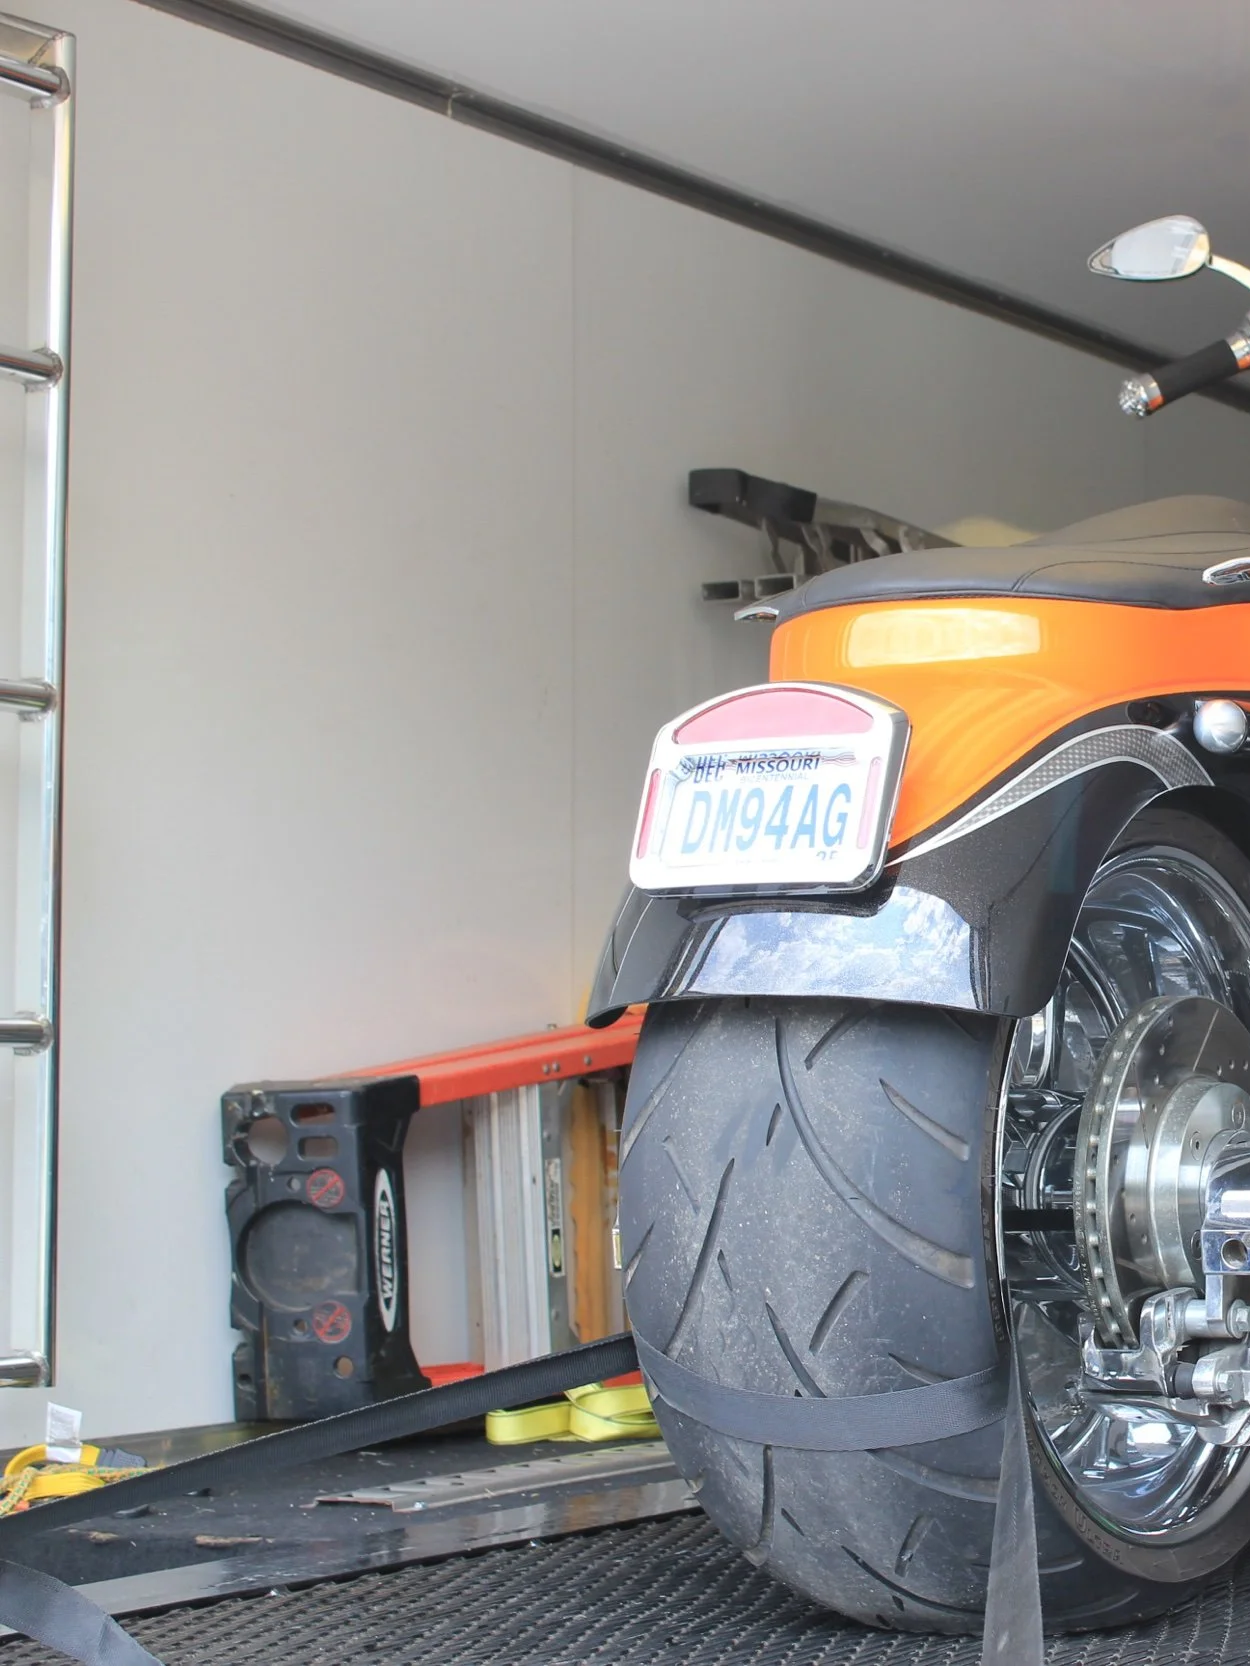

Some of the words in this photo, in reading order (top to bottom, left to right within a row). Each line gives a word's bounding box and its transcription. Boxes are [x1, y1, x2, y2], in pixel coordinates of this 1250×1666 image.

[736, 757, 821, 775] MISSOURI
[680, 783, 852, 854] DM94AG
[379, 1200, 393, 1299] WERNER
